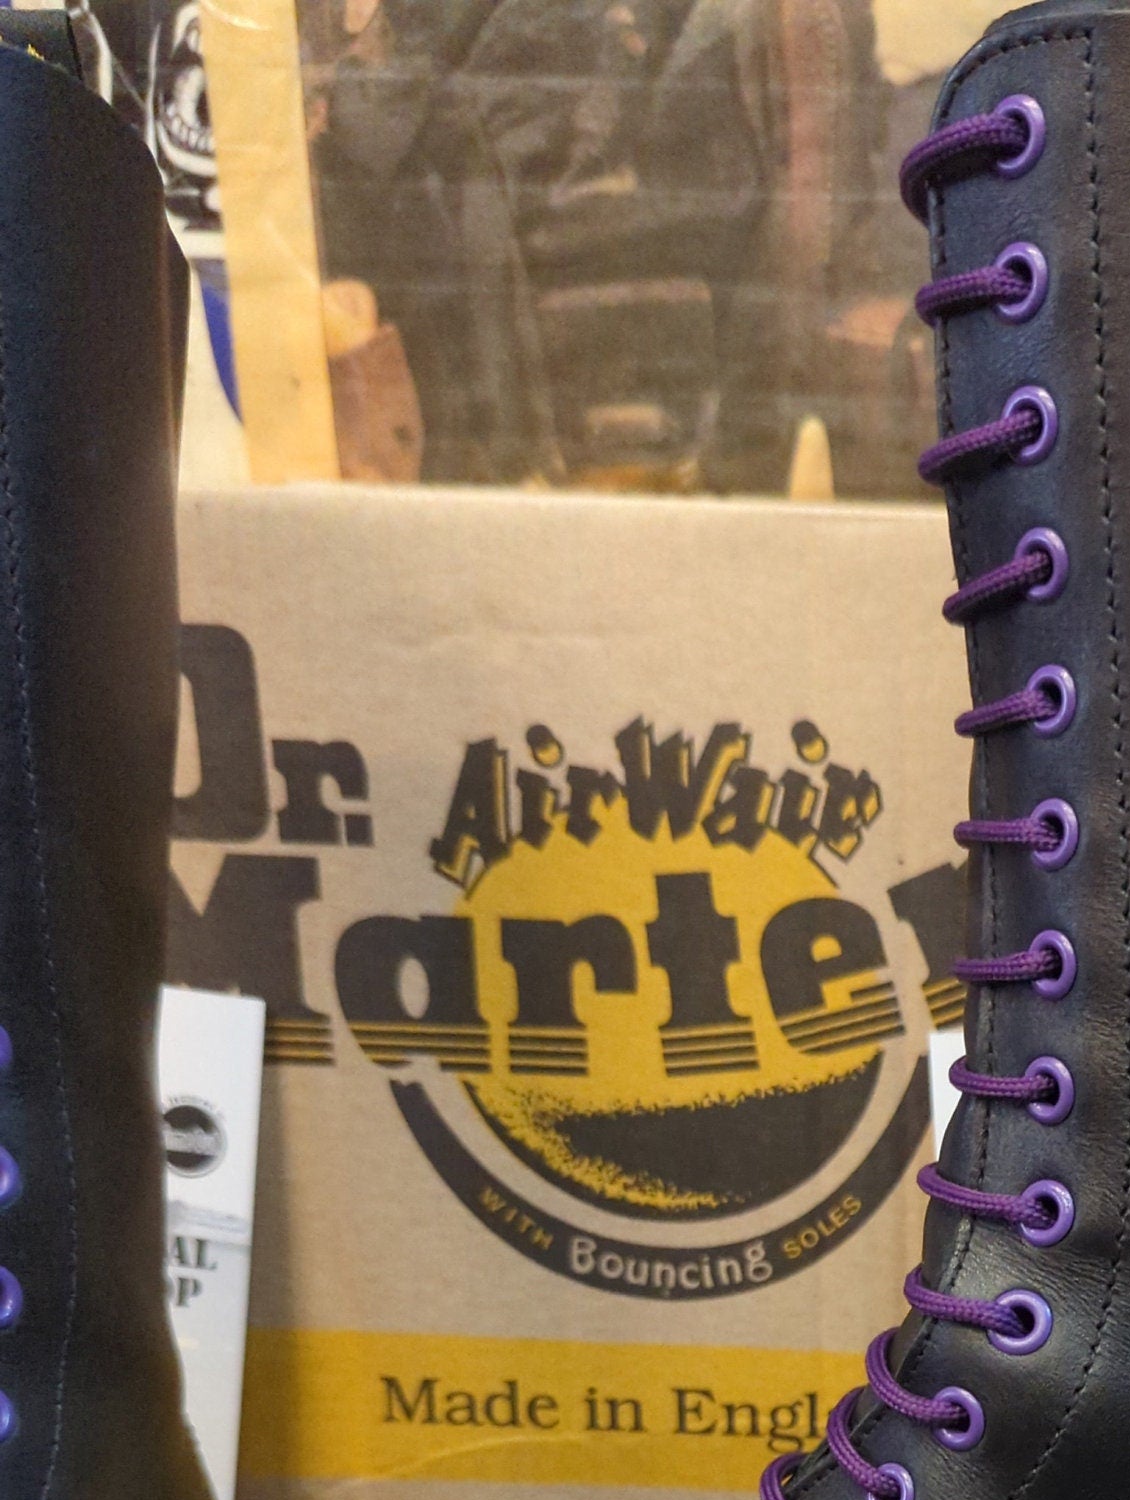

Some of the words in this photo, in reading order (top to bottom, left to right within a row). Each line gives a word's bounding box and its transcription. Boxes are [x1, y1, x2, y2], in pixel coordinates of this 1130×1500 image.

[479, 1186, 556, 1252] WITH
[569, 1233, 773, 1293] Bouncing
[780, 1193, 863, 1260] SOLES
[379, 1383, 560, 1428] Made
[586, 1387, 646, 1432] in
[670, 1387, 829, 1454] Engl
